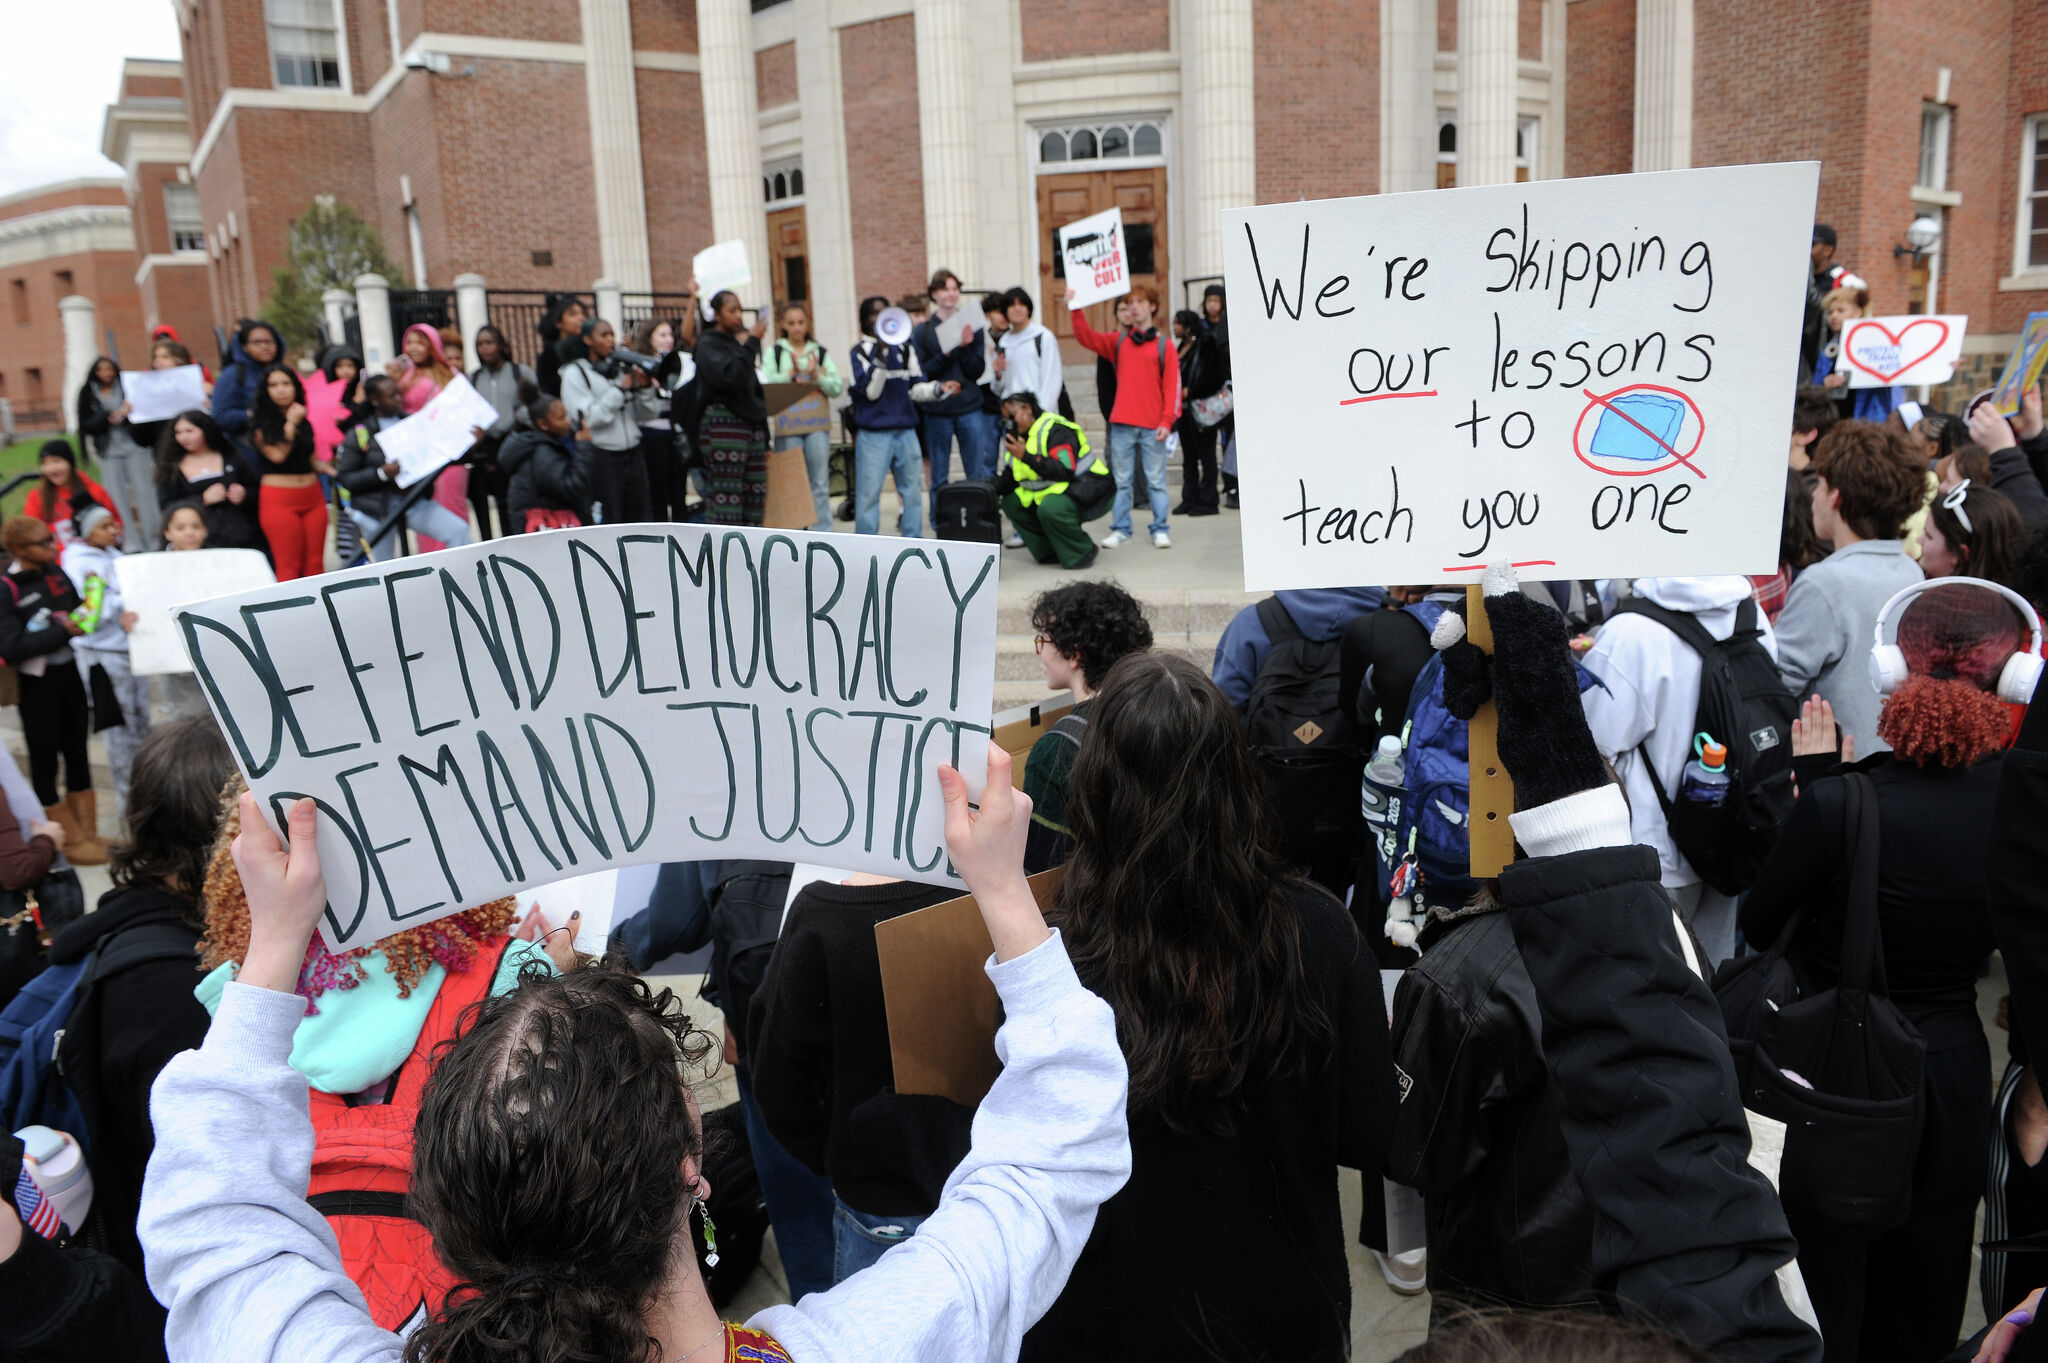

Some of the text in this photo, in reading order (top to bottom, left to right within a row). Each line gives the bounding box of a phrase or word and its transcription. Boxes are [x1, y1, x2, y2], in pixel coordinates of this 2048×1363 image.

[1094, 267, 1122, 288] CULT
[1245, 222, 1429, 320] We're
[1348, 312, 1715, 394] our lessons
[1455, 399, 1535, 449] to
[1283, 466, 1691, 557] teach you one
[178, 531, 995, 779] DEFEND DEMOCRACY
[269, 713, 655, 943] DEMAND
[1387, 796, 1401, 825] 2025
